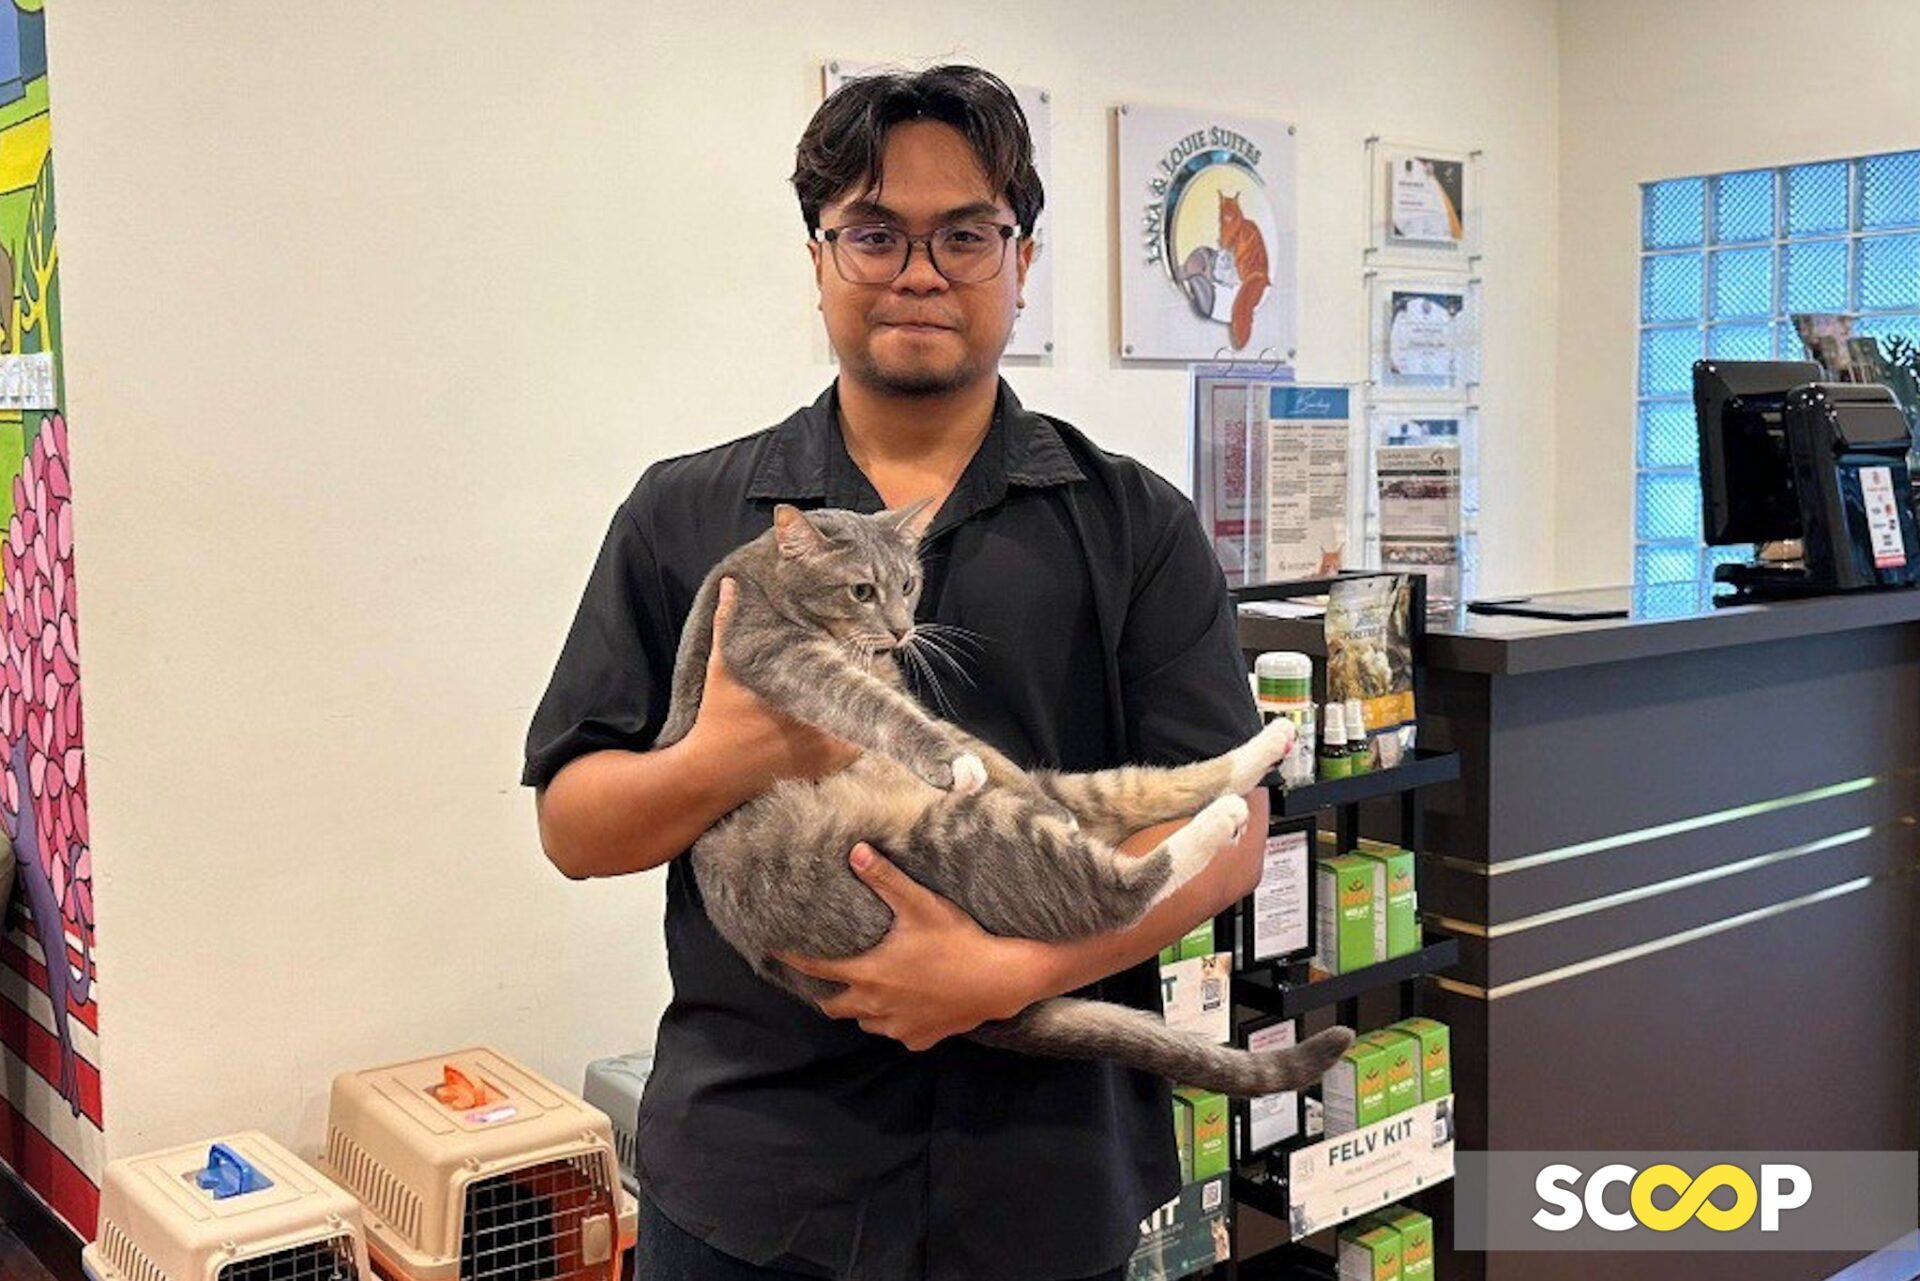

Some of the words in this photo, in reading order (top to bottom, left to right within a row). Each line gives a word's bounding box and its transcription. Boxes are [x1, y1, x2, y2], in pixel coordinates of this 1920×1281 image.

[1162, 129, 1208, 177] LOUIE
[1210, 125, 1263, 166] SUITES
[1151, 178, 1169, 196] &
[1147, 202, 1162, 265] LANA
[1328, 1131, 1377, 1167] FELV
[1383, 1118, 1414, 1147] KIT
